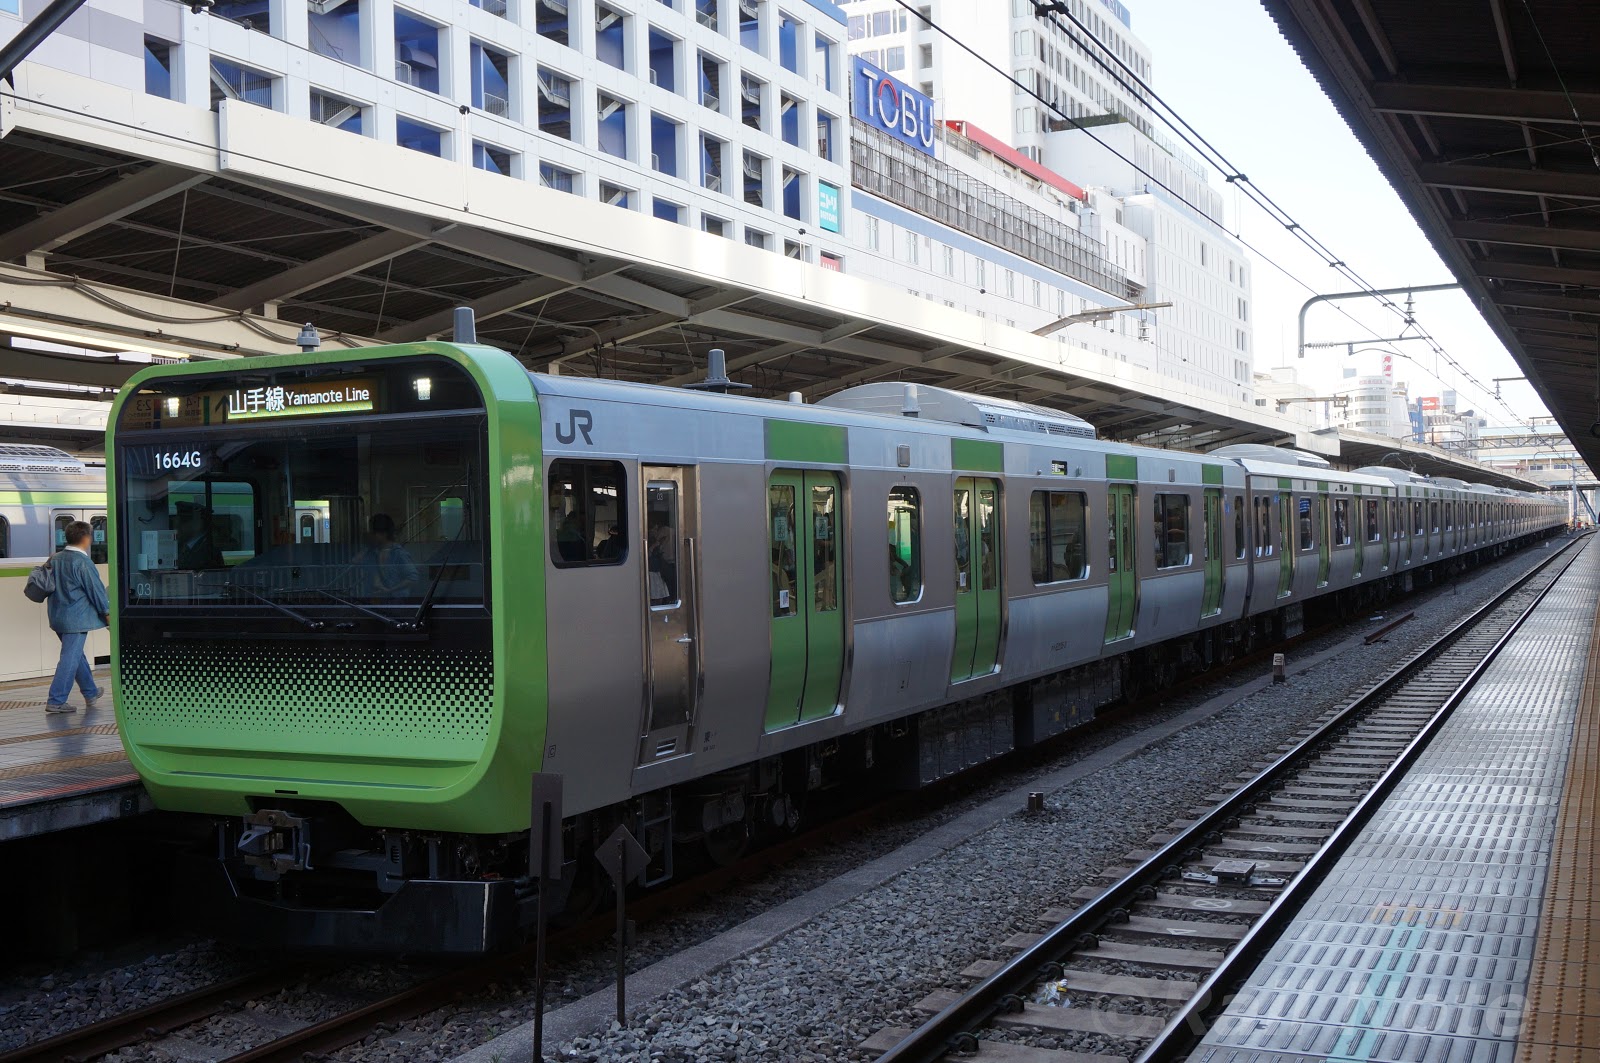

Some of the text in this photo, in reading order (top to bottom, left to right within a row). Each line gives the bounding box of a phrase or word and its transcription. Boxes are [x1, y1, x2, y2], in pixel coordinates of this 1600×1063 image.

[862, 67, 934, 148] TOBU
[229, 386, 286, 415] 山手線
[285, 387, 370, 407] Yamanote Line
[555, 409, 593, 445] JR
[154, 451, 201, 470] 1664G
[137, 582, 152, 596] 03
